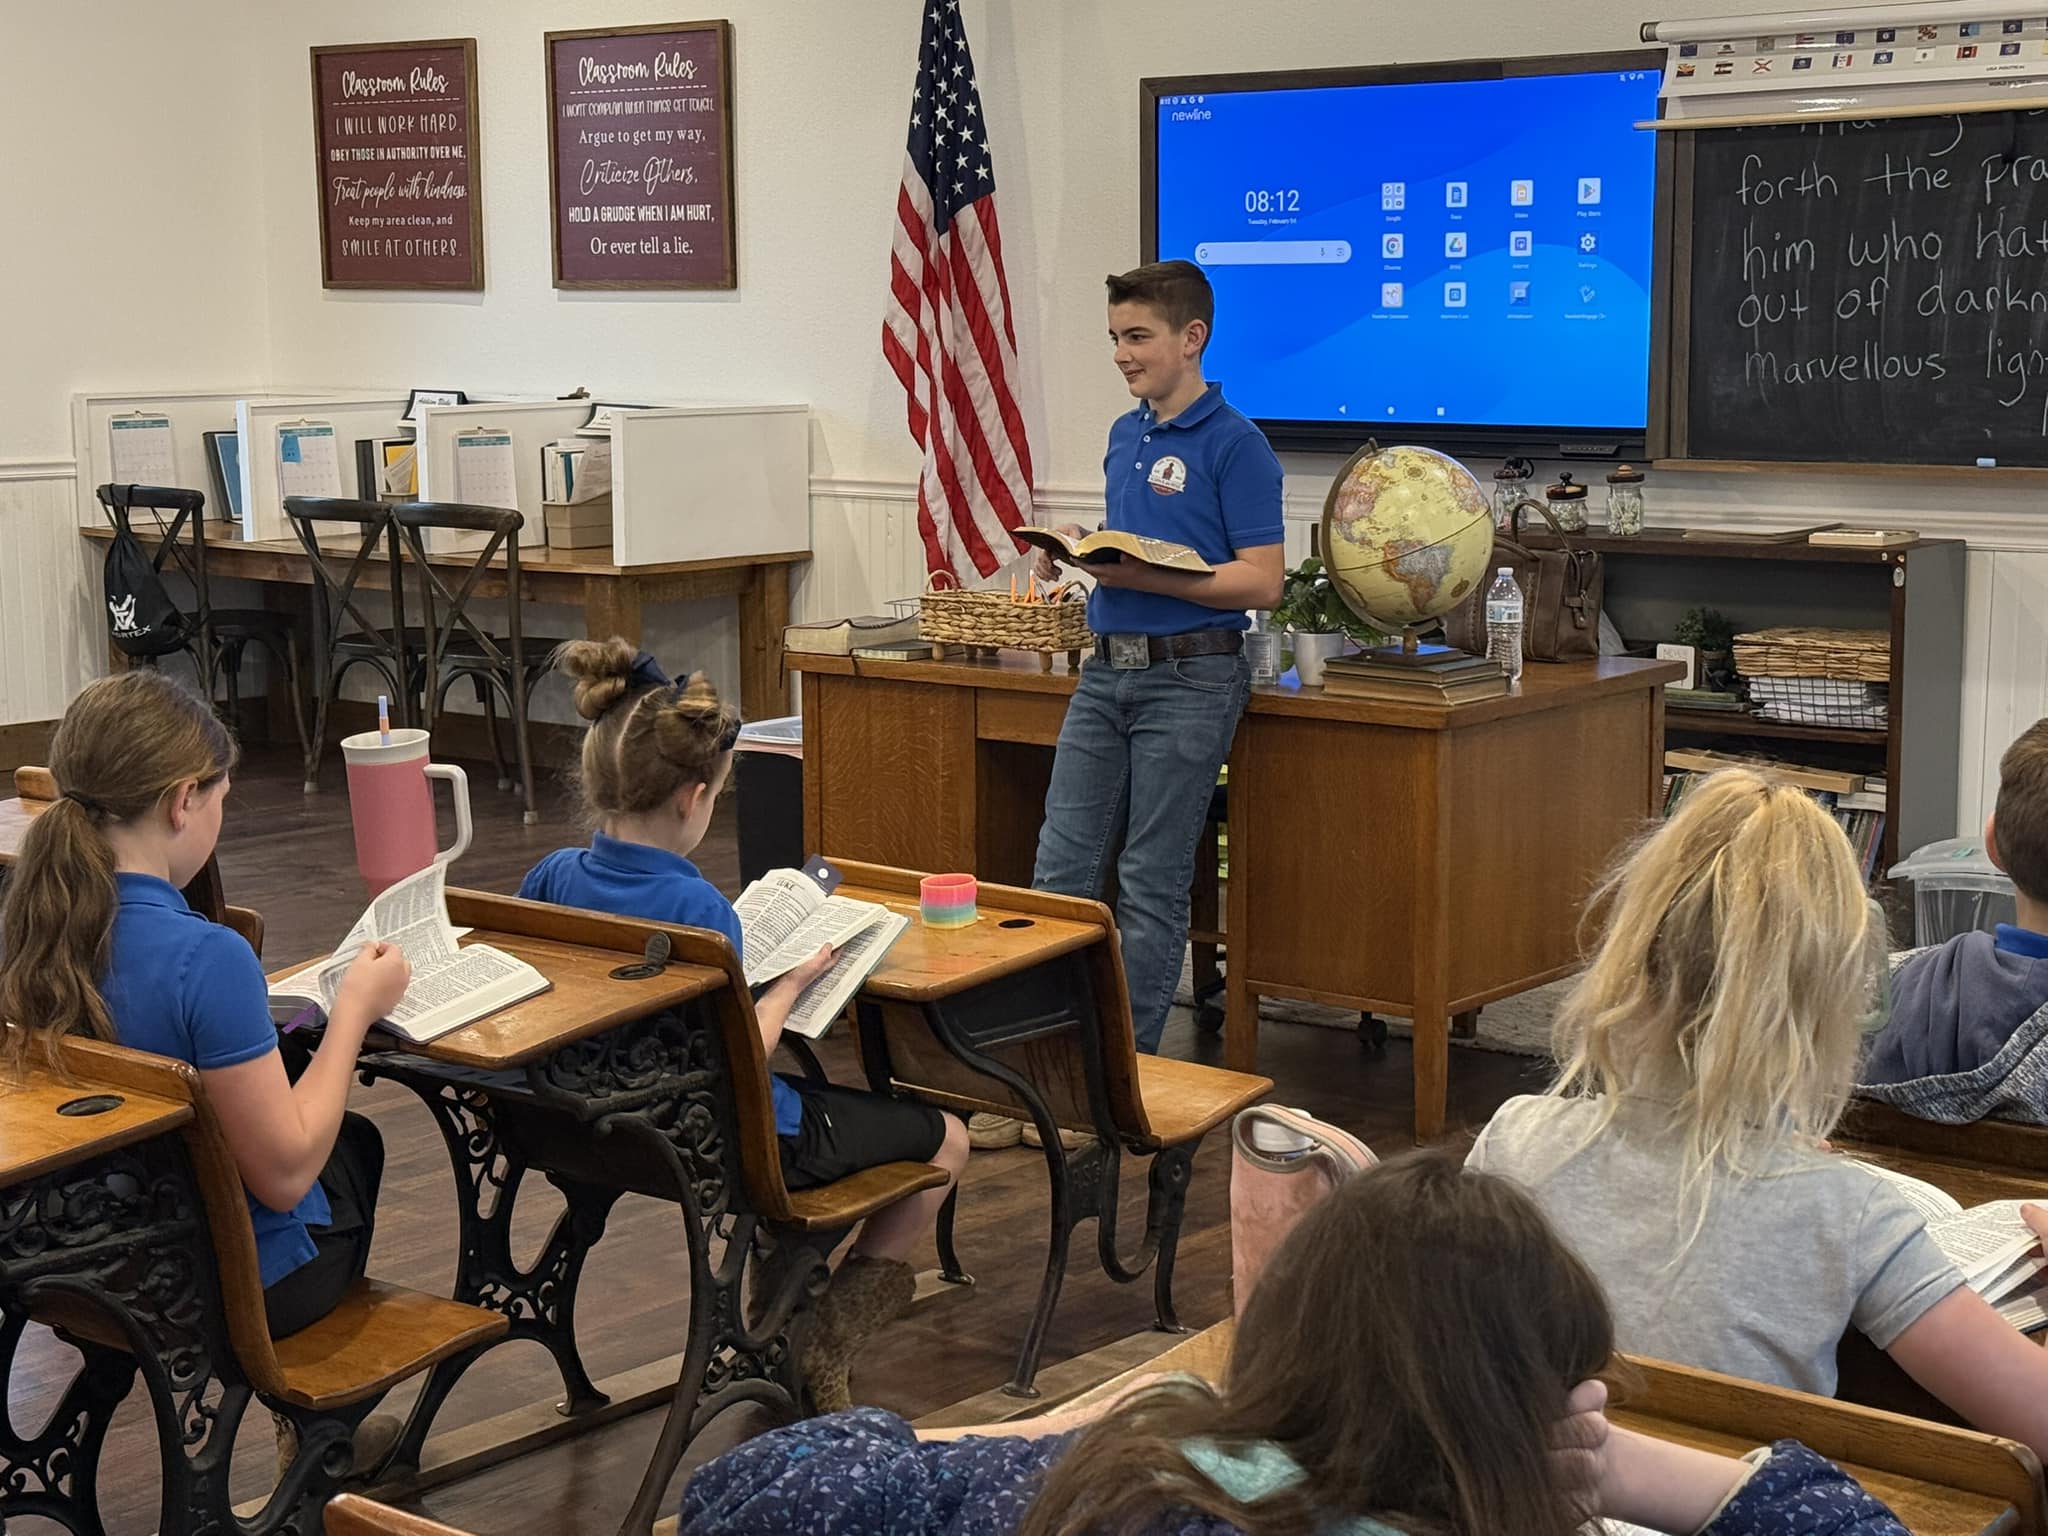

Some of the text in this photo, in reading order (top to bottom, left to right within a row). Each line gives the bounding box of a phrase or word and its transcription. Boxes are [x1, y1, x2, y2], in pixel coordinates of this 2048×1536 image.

[579, 52, 698, 87] Classroom Rules
[342, 67, 449, 99] Classroom Rules
[588, 101, 624, 117] COMPLAIN
[625, 100, 645, 115] WHEN
[646, 98, 672, 114] THINGS
[672, 97, 689, 112] GET
[1171, 108, 1212, 121] newline
[335, 113, 463, 135] I WILL WORK HARD.
[579, 129, 615, 147] Argue
[617, 130, 629, 143] to
[633, 130, 652, 147] get
[655, 129, 674, 145] my
[330, 148, 350, 162] OBEY
[351, 148, 375, 161] THOSE
[376, 147, 385, 160] IN
[386, 146, 428, 161] AUTHORITY
[430, 145, 451, 159] OVER
[579, 158, 640, 196] Criticize
[1736, 154, 1838, 206] forth
[1863, 153, 1952, 196] the
[332, 175, 367, 207] Treat
[363, 171, 396, 209] people
[398, 170, 427, 200] with
[1245, 189, 1300, 213] 08:12
[349, 215, 370, 229] Keep
[371, 217, 384, 229] my
[386, 216, 406, 226] area
[436, 213, 453, 225] and
[568, 206, 591, 223] HOLD
[592, 206, 600, 222] A
[600, 205, 636, 222] GRUDGE
[637, 204, 664, 222] WHEN
[664, 204, 669, 221] I
[670, 204, 686, 221] AM
[342, 238, 381, 257] SMILE
[385, 238, 402, 258] AT
[590, 235, 694, 255] Or ever tell a lie.
[1744, 221, 1815, 281] him
[1850, 217, 1943, 268] who
[1738, 288, 1809, 328] out
[1837, 275, 1889, 320] of
[1985, 329, 2048, 407] ligh
